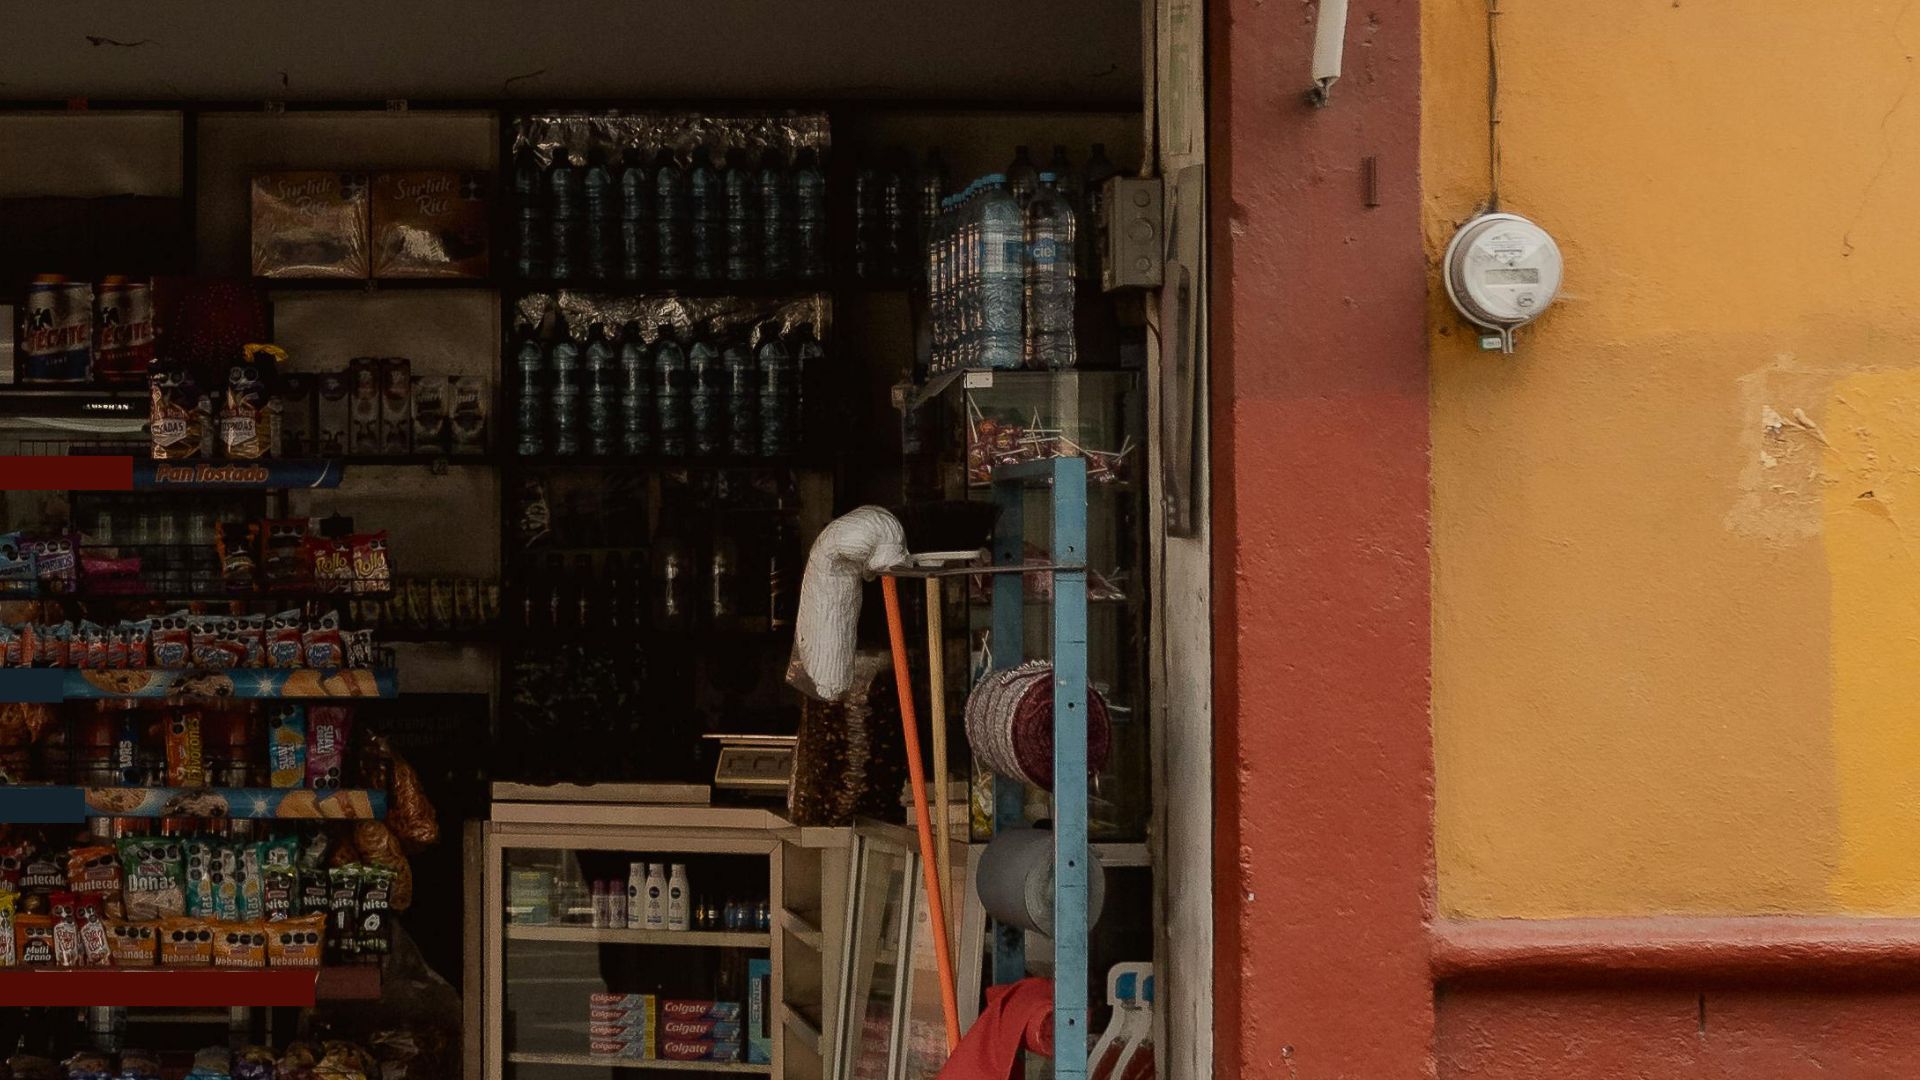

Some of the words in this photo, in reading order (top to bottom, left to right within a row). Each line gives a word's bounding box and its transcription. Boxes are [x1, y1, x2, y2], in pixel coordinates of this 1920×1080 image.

[1033, 246, 1056, 258] ciel
[27, 323, 88, 351] TECATE
[101, 320, 151, 349] ECATE
[155, 464, 194, 483] Pan
[195, 462, 270, 483] Tostado
[127, 872, 177, 892] Donas
[265, 899, 290, 911] Nito
[303, 896, 328, 906] Nito
[330, 899, 355, 910] Nito
[363, 899, 388, 912] Nito
[26, 945, 49, 954] Multi
[112, 949, 153, 960] ebanadas
[24, 953, 51, 962] Grano
[162, 953, 210, 963] Rebanadas
[269, 957, 319, 967] Rebanadas
[664, 1002, 707, 1014] Colgate
[591, 1026, 622, 1035] Colgate
[665, 1022, 708, 1034] Colgate
[591, 1042, 622, 1051] Colgate
[664, 1042, 708, 1054] Colgate
